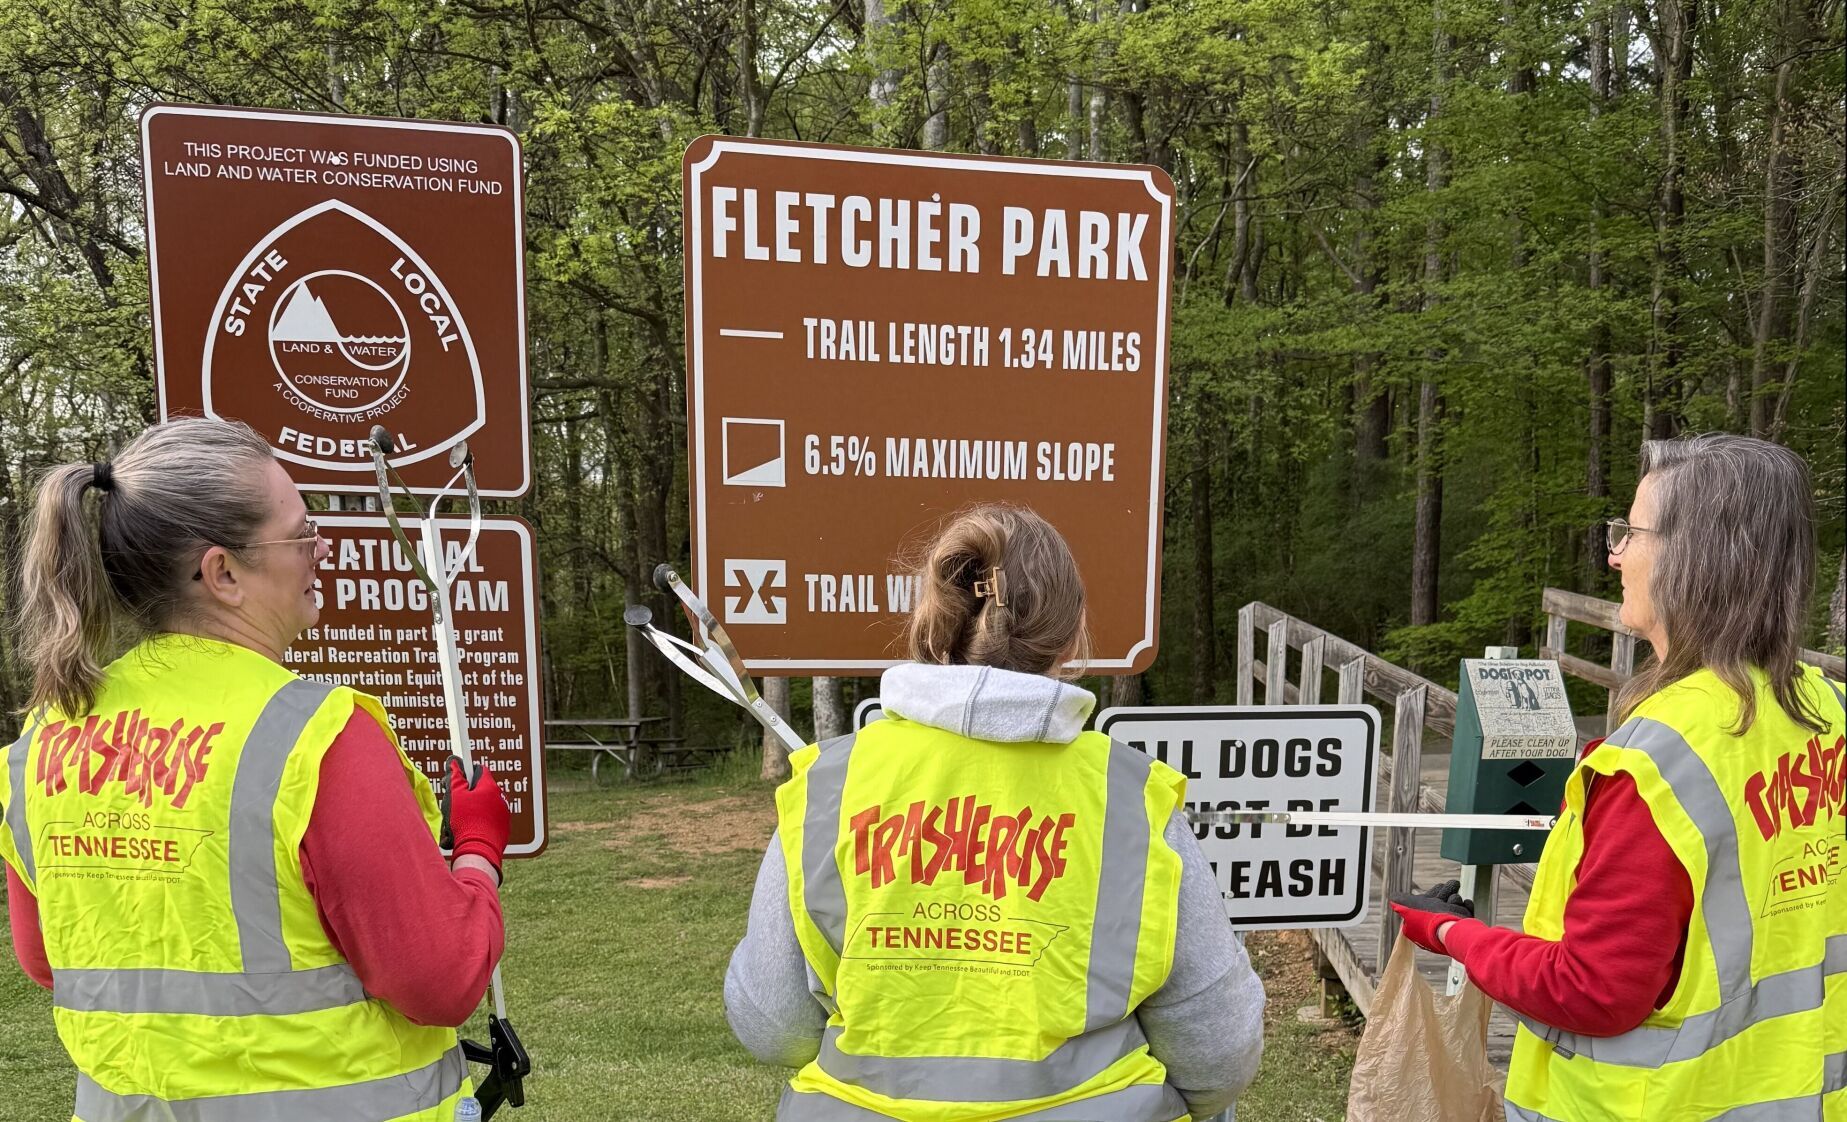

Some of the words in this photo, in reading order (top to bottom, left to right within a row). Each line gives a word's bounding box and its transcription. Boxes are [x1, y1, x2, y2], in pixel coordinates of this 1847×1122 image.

[184, 142, 221, 158] THIS
[227, 145, 306, 162] PROJECT
[310, 150, 348, 166] WAS
[354, 153, 422, 170] FUNDED
[428, 158, 478, 174] USING
[164, 162, 211, 177] LAND
[216, 165, 252, 180] AND
[257, 168, 318, 184] WATER
[322, 171, 452, 192] CONSERVATION
[458, 180, 502, 195] FUND
[712, 186, 980, 274] FLETCHER
[1002, 206, 1150, 282] PARK
[225, 249, 288, 336] STATE
[390, 258, 460, 352] LOCAL
[282, 342, 320, 353] LAND
[324, 344, 333, 354] &
[349, 346, 396, 356] WATER
[804, 318, 880, 362] TRAIL
[889, 322, 990, 366] LENGTH
[998, 328, 1054, 369] 1.34
[1062, 330, 1142, 372] MILES
[294, 374, 388, 387] CONSERVATION
[273, 382, 283, 392] A
[283, 390, 365, 423] COOPERATIVE
[367, 384, 411, 420] PROJECT
[325, 388, 358, 398] FUND
[804, 434, 876, 476] 6.5%
[885, 437, 1028, 481] MAXIMUM
[1036, 441, 1115, 482] SLOPE
[336, 578, 510, 612] PROGAM
[804, 574, 879, 612] TRAIL
[324, 624, 374, 641] funded
[379, 625, 391, 640] in
[396, 626, 427, 644] part
[464, 627, 504, 645] grant
[282, 646, 324, 663] deral
[328, 646, 410, 664] Recreation
[457, 647, 519, 667] Program
[407, 669, 442, 689] Equit
[460, 670, 478, 685] ct
[483, 670, 496, 685] of
[500, 670, 523, 685] the
[474, 692, 490, 710] by
[494, 692, 517, 707] the
[466, 713, 516, 731] ivision,
[499, 735, 523, 750] and
[1490, 749, 1517, 758] AFTER
[1520, 749, 1543, 757] YOUR
[1546, 749, 1568, 757] DOG!
[1491, 739, 1524, 748] PLEASE
[1527, 739, 1554, 747] CLEAN
[36, 708, 226, 810] TRASHERCISE
[426, 757, 439, 772] in
[1128, 740, 1201, 779] LL
[1219, 738, 1342, 778] DOGS
[514, 777, 528, 792] of
[83, 811, 150, 831] ACROSS
[48, 835, 180, 862] TENNESSEE
[850, 794, 1076, 903] TRASHERCISE
[1209, 858, 1346, 899] EASH
[912, 902, 1001, 922] ACROSS
[866, 927, 1032, 955] TENNESSEE
[905, 964, 912, 972] by
[914, 964, 932, 972] Keep
[933, 964, 968, 972] Tennessee
[970, 966, 999, 975] Beautiful
